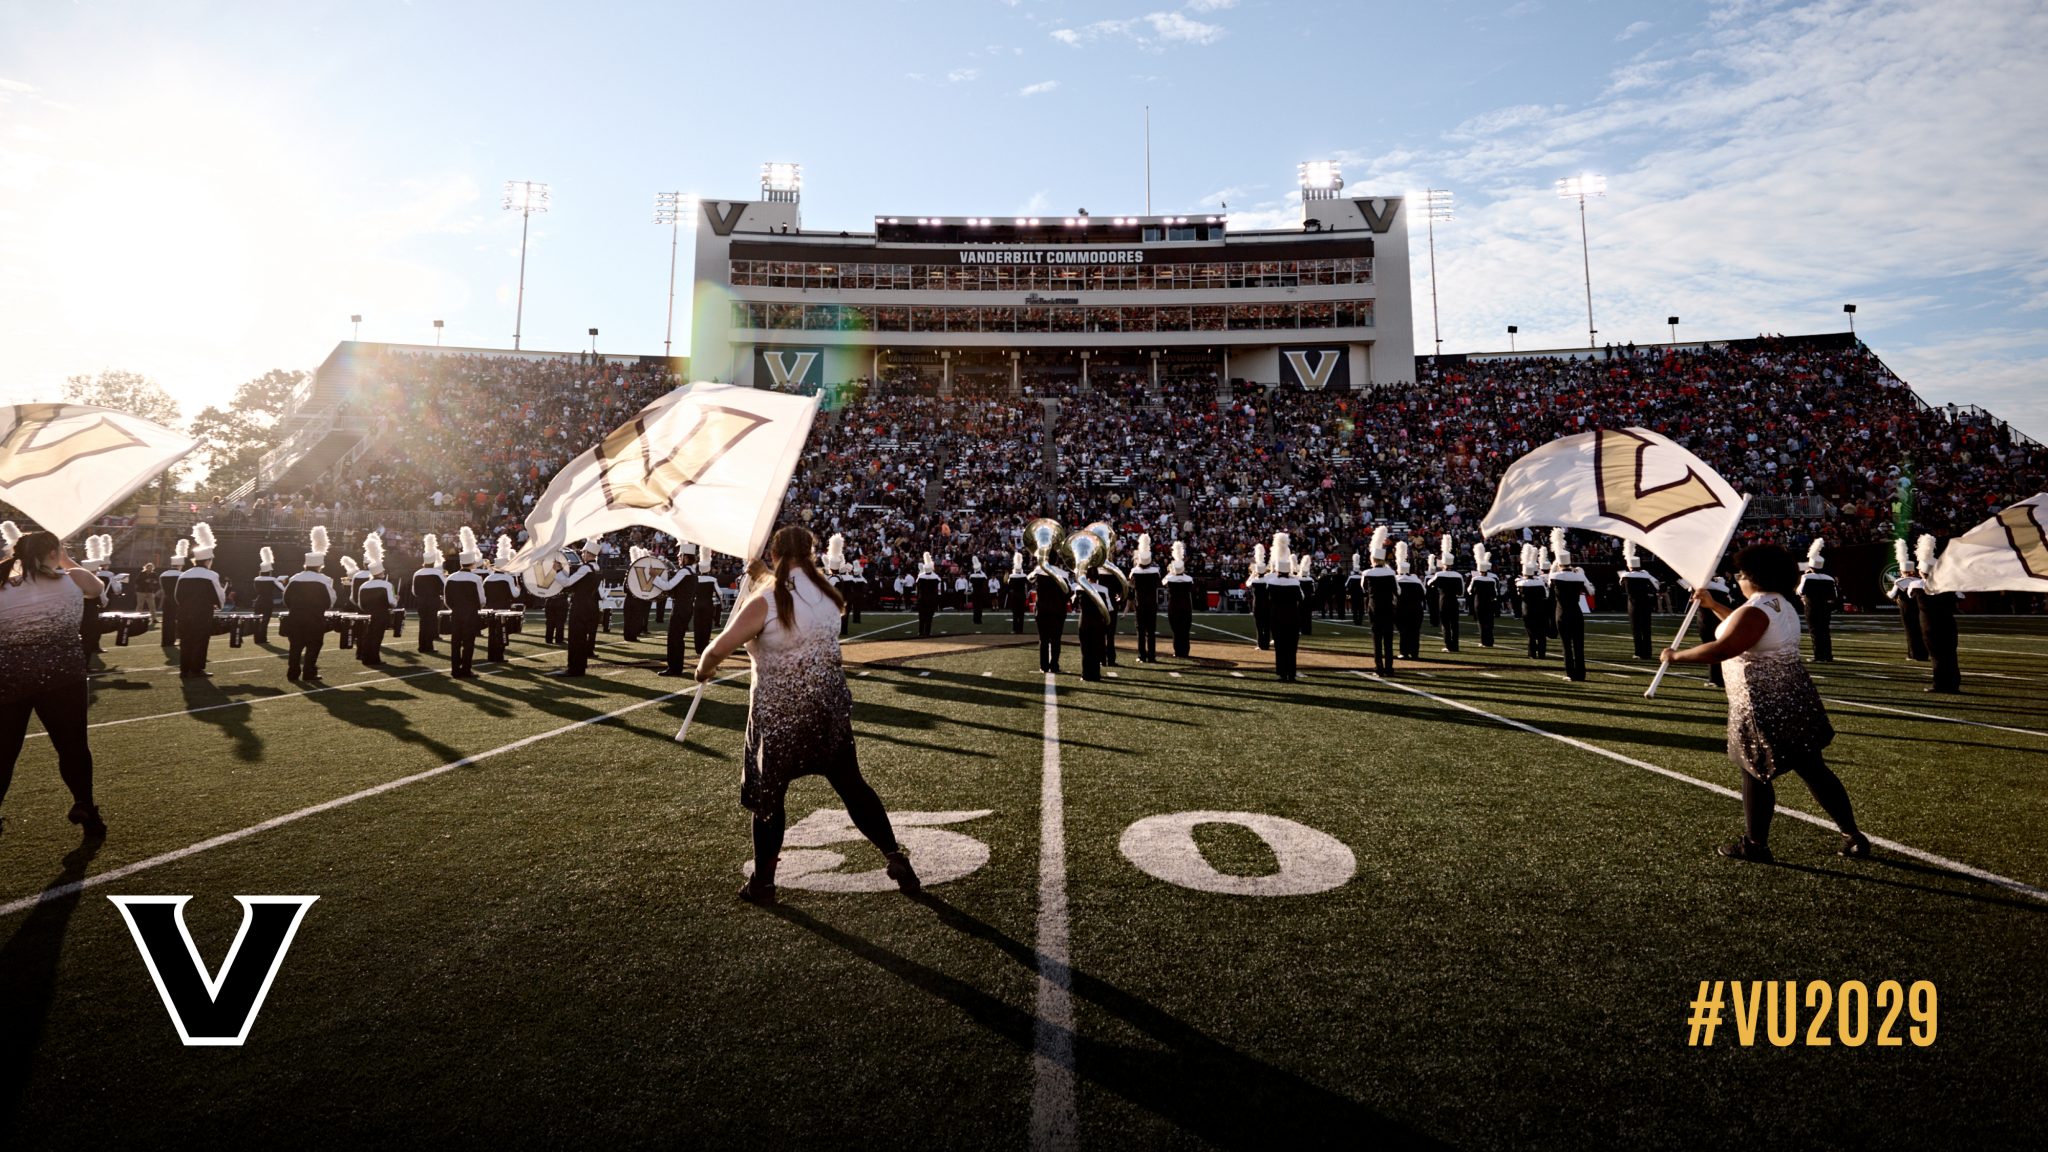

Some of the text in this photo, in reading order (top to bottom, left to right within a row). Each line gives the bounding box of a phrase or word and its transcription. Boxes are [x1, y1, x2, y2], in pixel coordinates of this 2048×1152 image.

[702, 202, 749, 236] V
[1354, 200, 1401, 233] V
[959, 250, 1144, 264] VANDERBILT COMMODORES
[763, 351, 819, 388] V
[1283, 351, 1341, 391] V
[594, 404, 774, 516] V
[1594, 427, 1726, 533] V
[634, 567, 665, 592] V
[1763, 598, 1782, 613] V
